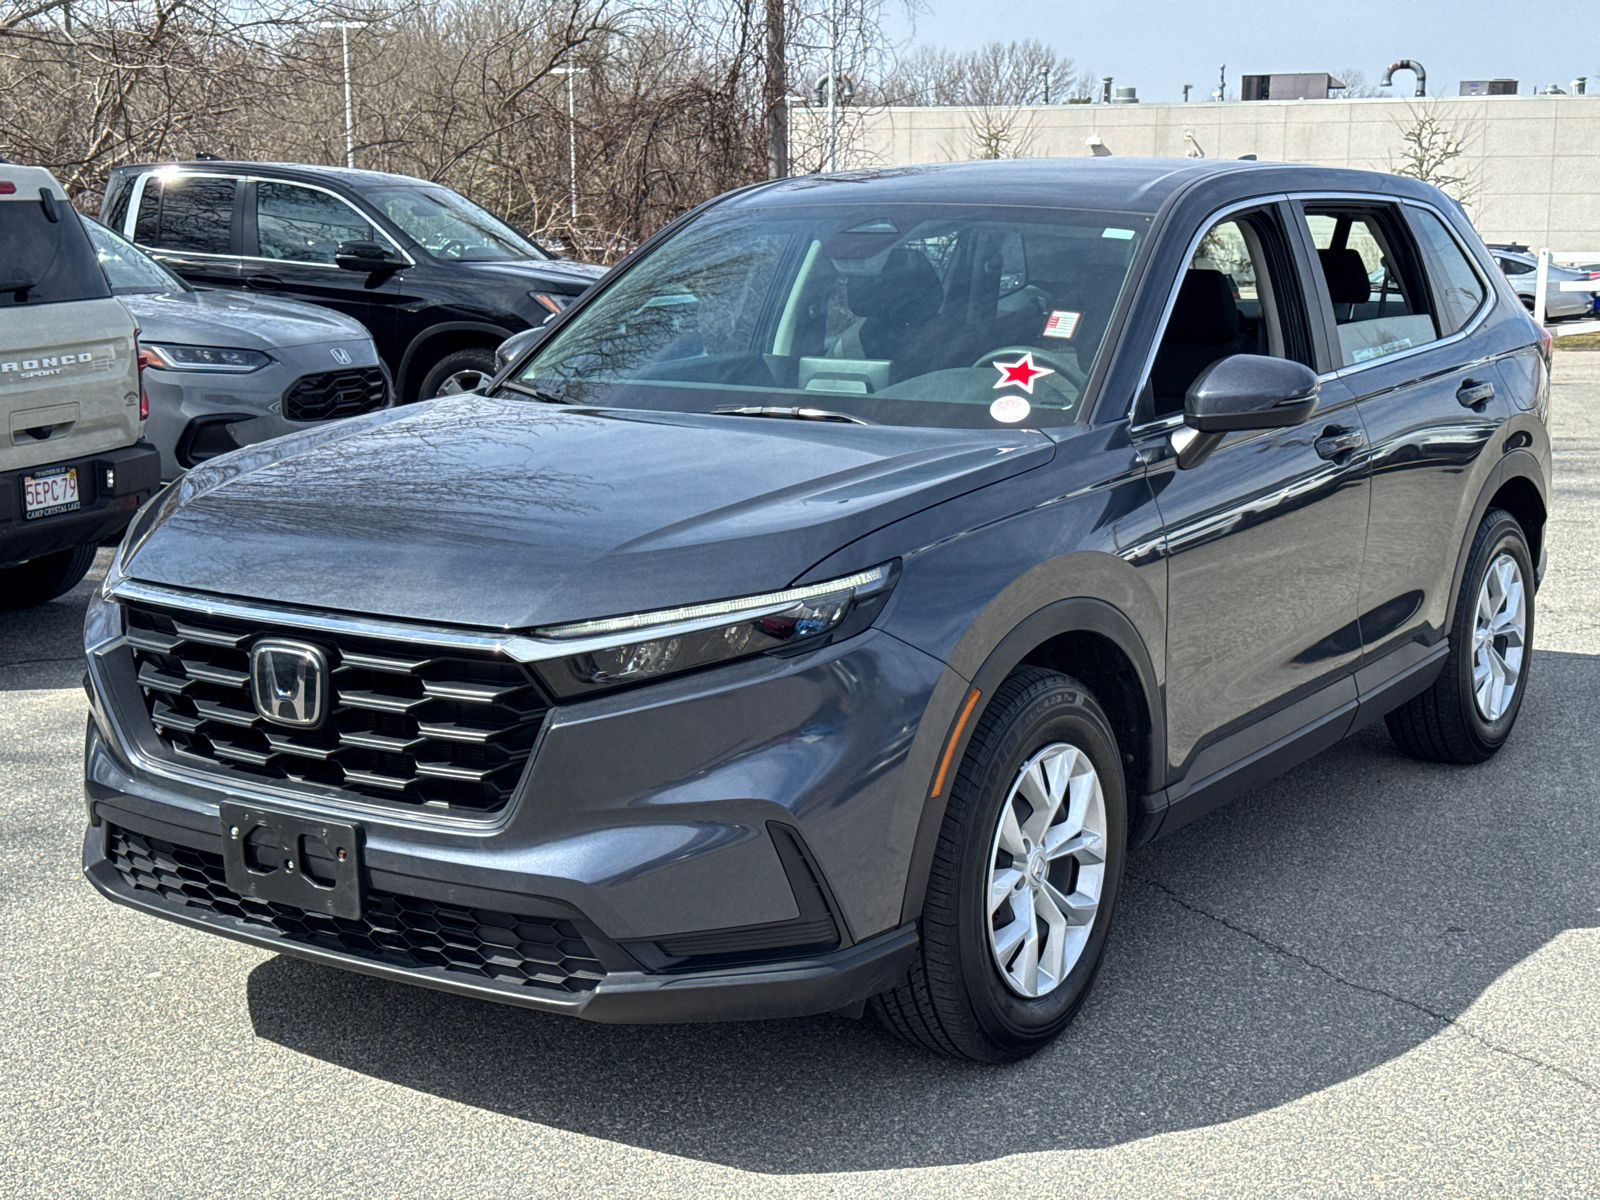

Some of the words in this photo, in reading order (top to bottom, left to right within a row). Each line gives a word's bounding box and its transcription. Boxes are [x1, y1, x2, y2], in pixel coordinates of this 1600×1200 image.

[20, 368, 61, 379] SPORT
[26, 510, 44, 520] CAMP
[44, 505, 68, 517] CRYSTAL
[67, 501, 81, 511] LAKE
[1043, 694, 1062, 707] 422
